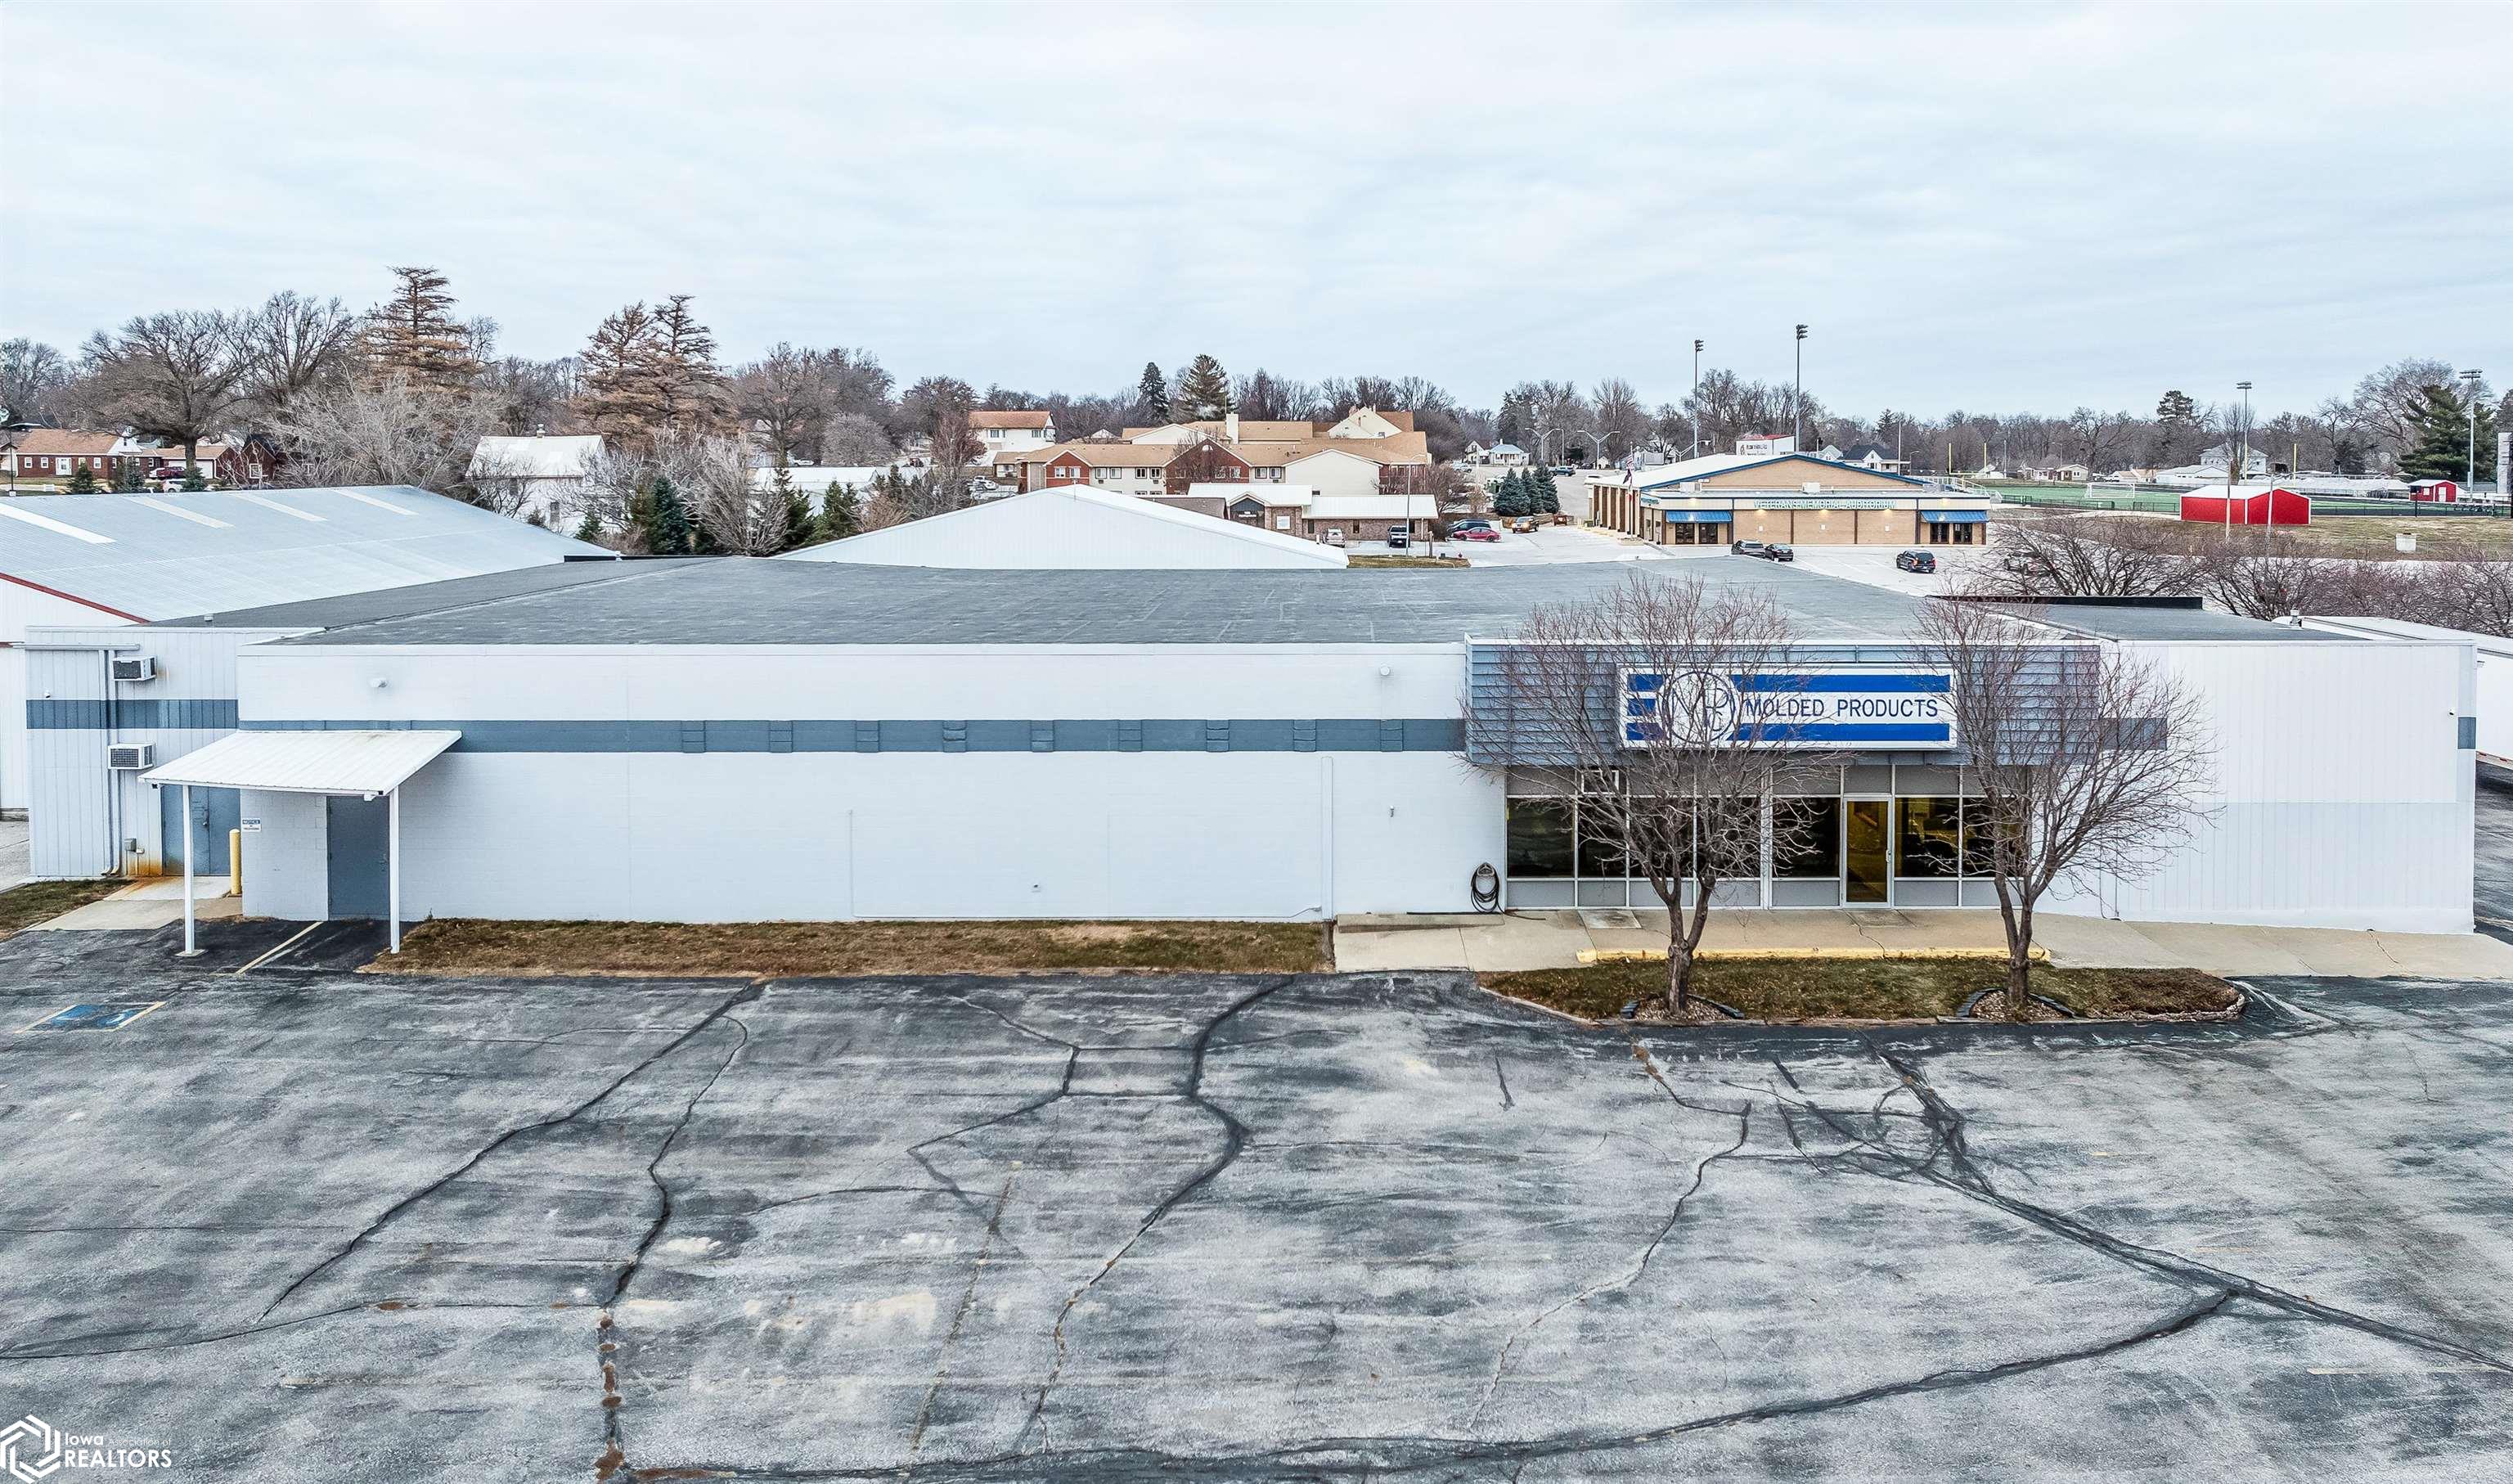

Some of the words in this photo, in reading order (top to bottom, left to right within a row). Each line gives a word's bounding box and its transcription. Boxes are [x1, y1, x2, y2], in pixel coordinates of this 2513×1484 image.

[1754, 499, 1798, 509] VETERANS
[1800, 499, 1845, 509] MEMORIAL
[1846, 499, 1897, 509] AUDITORIUM
[1746, 698, 1824, 717] MOLDED
[1837, 699, 1939, 717] PRODUCTS
